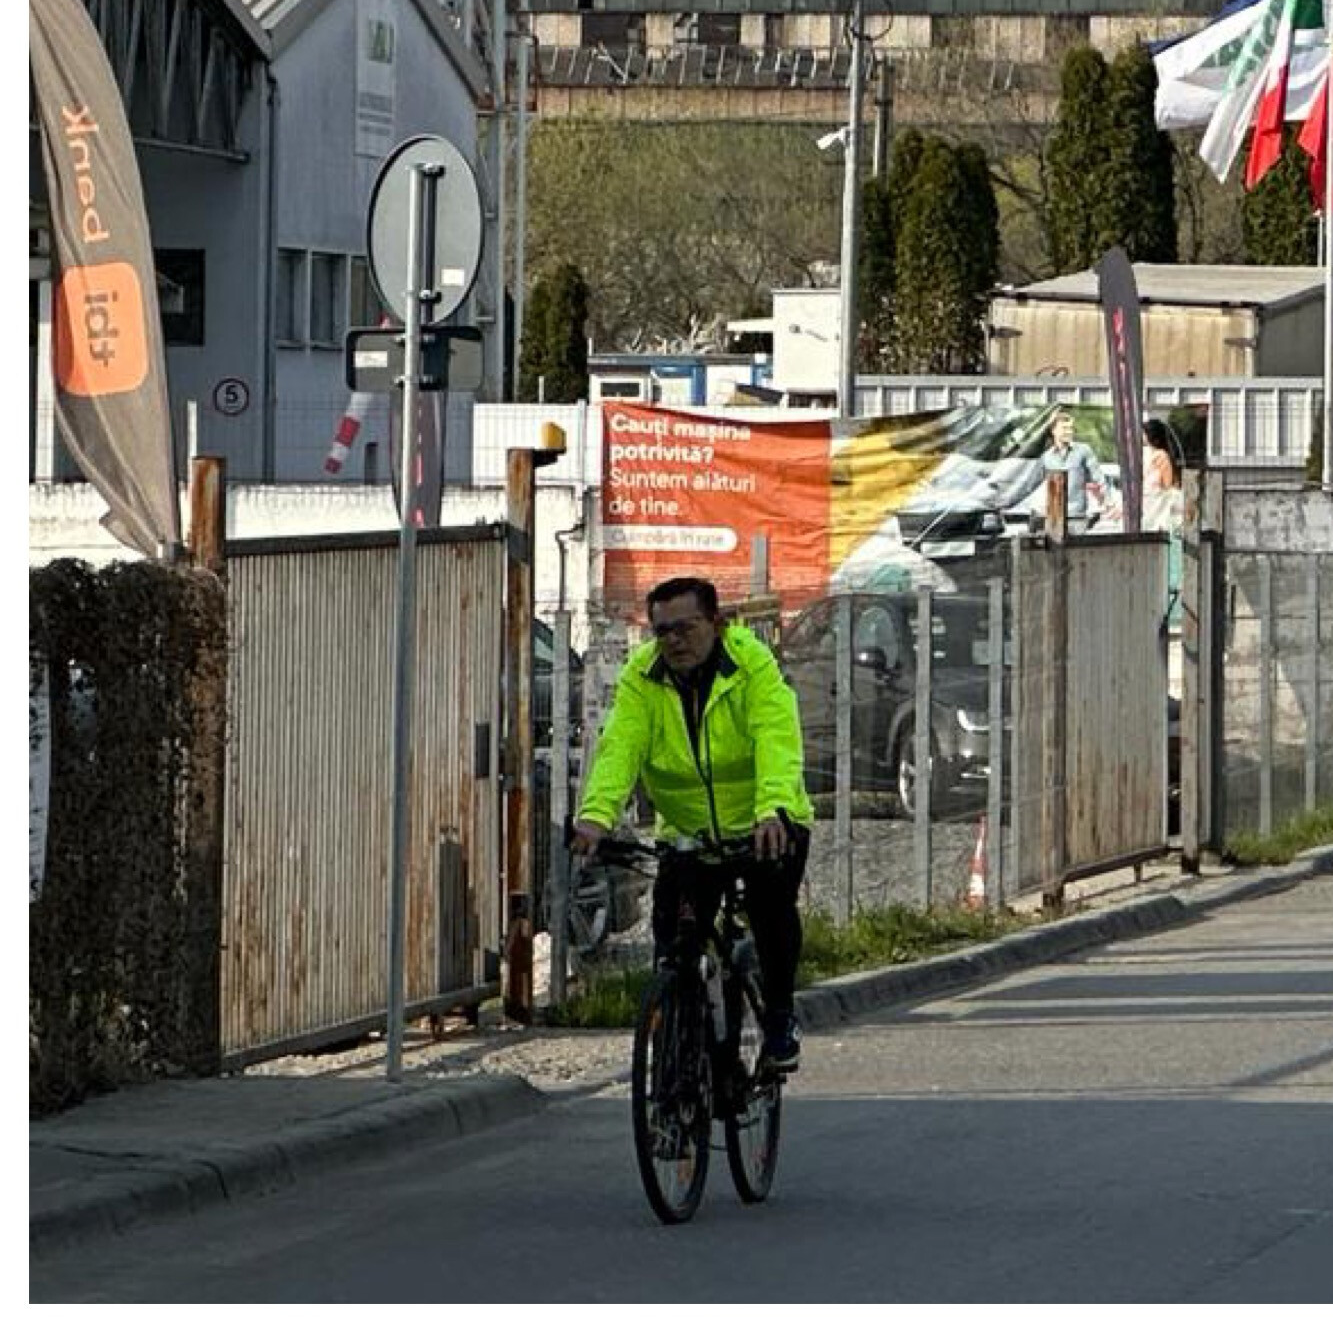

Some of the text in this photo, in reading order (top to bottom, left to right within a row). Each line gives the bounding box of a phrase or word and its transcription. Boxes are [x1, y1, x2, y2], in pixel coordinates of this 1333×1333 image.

[225, 384, 239, 404] 5
[610, 443, 714, 465] potrivită?
[609, 466, 757, 493] Suntem alături
[608, 495, 636, 515] de
